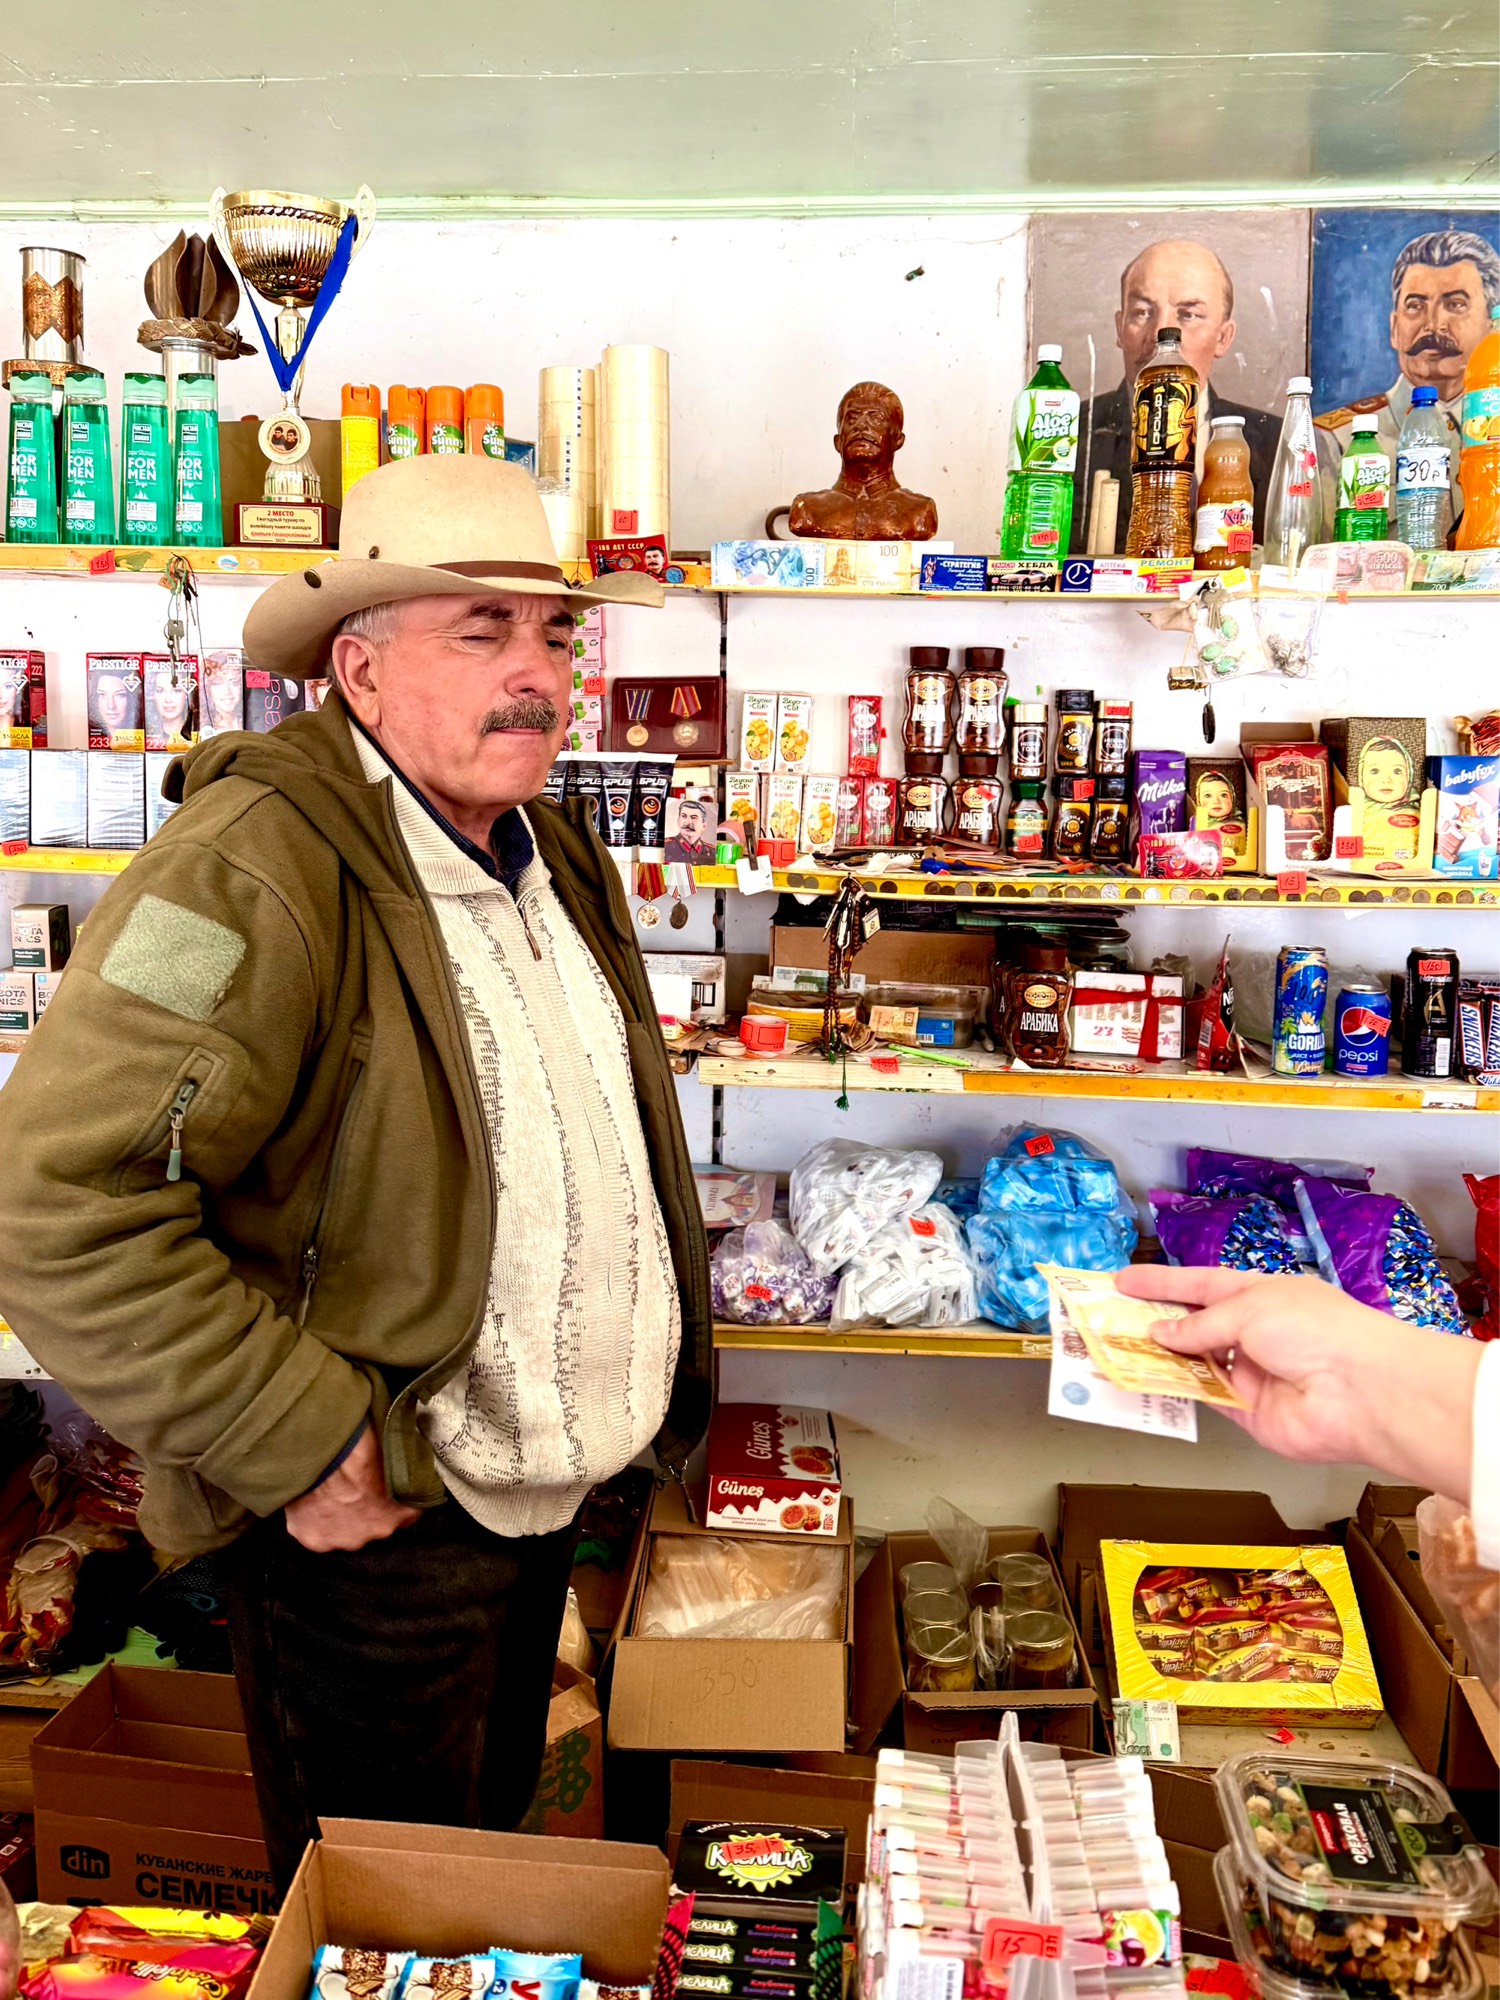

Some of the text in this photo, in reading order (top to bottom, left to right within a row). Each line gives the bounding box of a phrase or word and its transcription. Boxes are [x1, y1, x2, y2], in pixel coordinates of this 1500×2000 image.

[1031, 413, 1072, 431] Aloe
[1033, 425, 1069, 441] vera
[391, 444, 411, 458] day
[11, 453, 37, 466] FOR
[67, 455, 94, 468] FOR
[128, 457, 157, 469] FOR
[177, 457, 203, 470] FOR
[11, 464, 37, 477] MEN
[67, 467, 94, 479] MEN
[127, 468, 157, 481] MEN
[177, 468, 203, 481] MEN
[1356, 467, 1386, 482] Aloe
[879, 545, 899, 557] 100
[1140, 559, 1191, 567] РЕМОНТ
[1375, 552, 1398, 564] 500
[804, 567, 815, 587] 100
[0, 657, 28, 669] TIGE
[88, 658, 140, 671] PRESTIGE
[145, 660, 197, 673] PRESIGE
[31, 665, 43, 676] 222
[90, 737, 110, 748] 233
[146, 739, 166, 749] 222
[1444, 762, 1496, 788] babyfox
[1137, 778, 1186, 803] Milka
[1284, 877, 1295, 886] 15
[1426, 961, 1440, 970] 150
[1020, 1011, 1059, 1033] АРАБИКА
[1093, 1025, 1114, 1037] 23
[1461, 1005, 1482, 1068] SNICKERS
[1338, 1049, 1379, 1063] pepsi
[694, 1657, 758, 1703] 350
[1332, 1802, 1369, 1865] ОРЕХОВАЯ
[66, 1851, 106, 1875] din
[135, 1853, 274, 1884] КУБАНСКИЕ ЖАРЕ
[135, 1870, 280, 1916] СЕМЕЧК
[688, 1920, 736, 1935] ИСЛИЦА
[1001, 1937, 1026, 1954] 15
[683, 1944, 733, 1962] ИСЛИЦА
[676, 1975, 730, 1992] ИСЛИЦА
